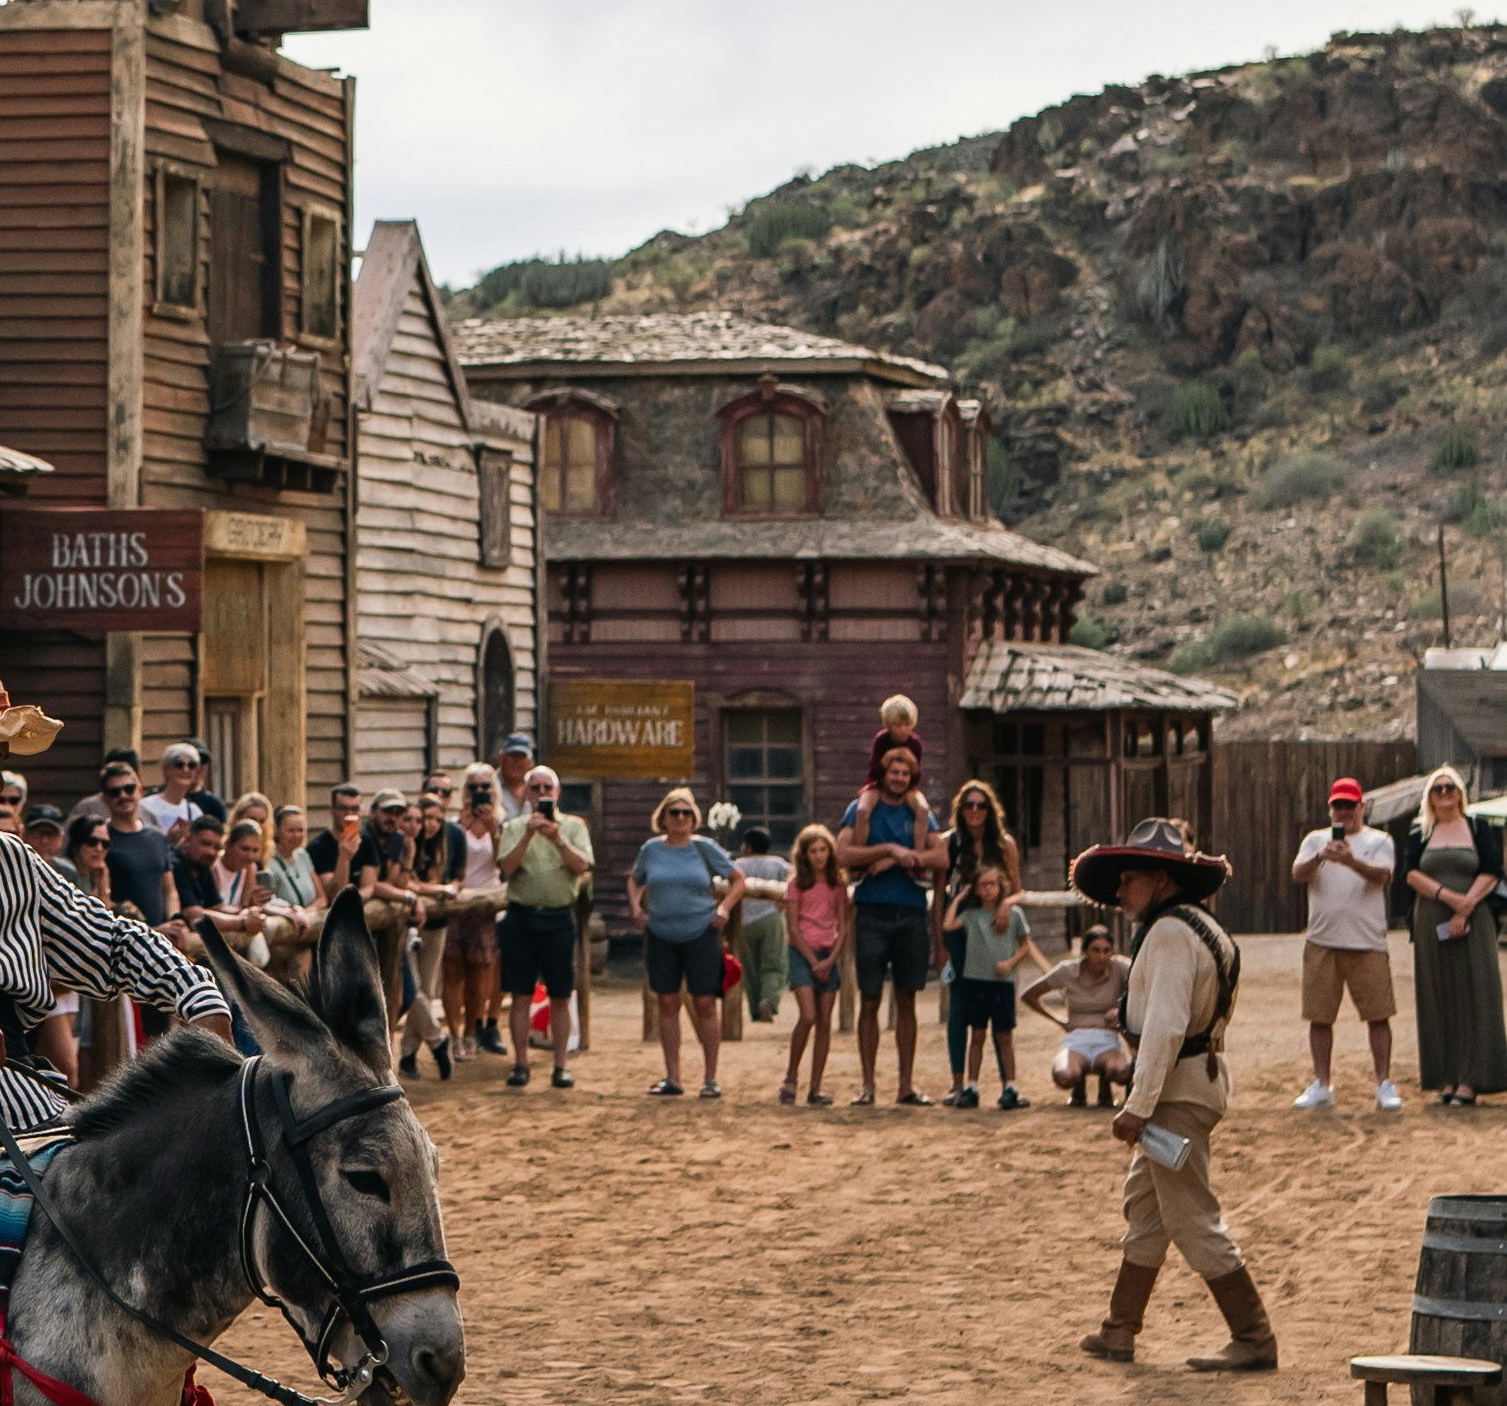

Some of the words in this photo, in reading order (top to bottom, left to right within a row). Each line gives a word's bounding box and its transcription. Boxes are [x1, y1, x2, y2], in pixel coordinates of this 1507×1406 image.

[52, 531, 149, 569] BATHS
[13, 571, 187, 610] JOHNSON'S
[557, 717, 685, 747] HARDWARE
